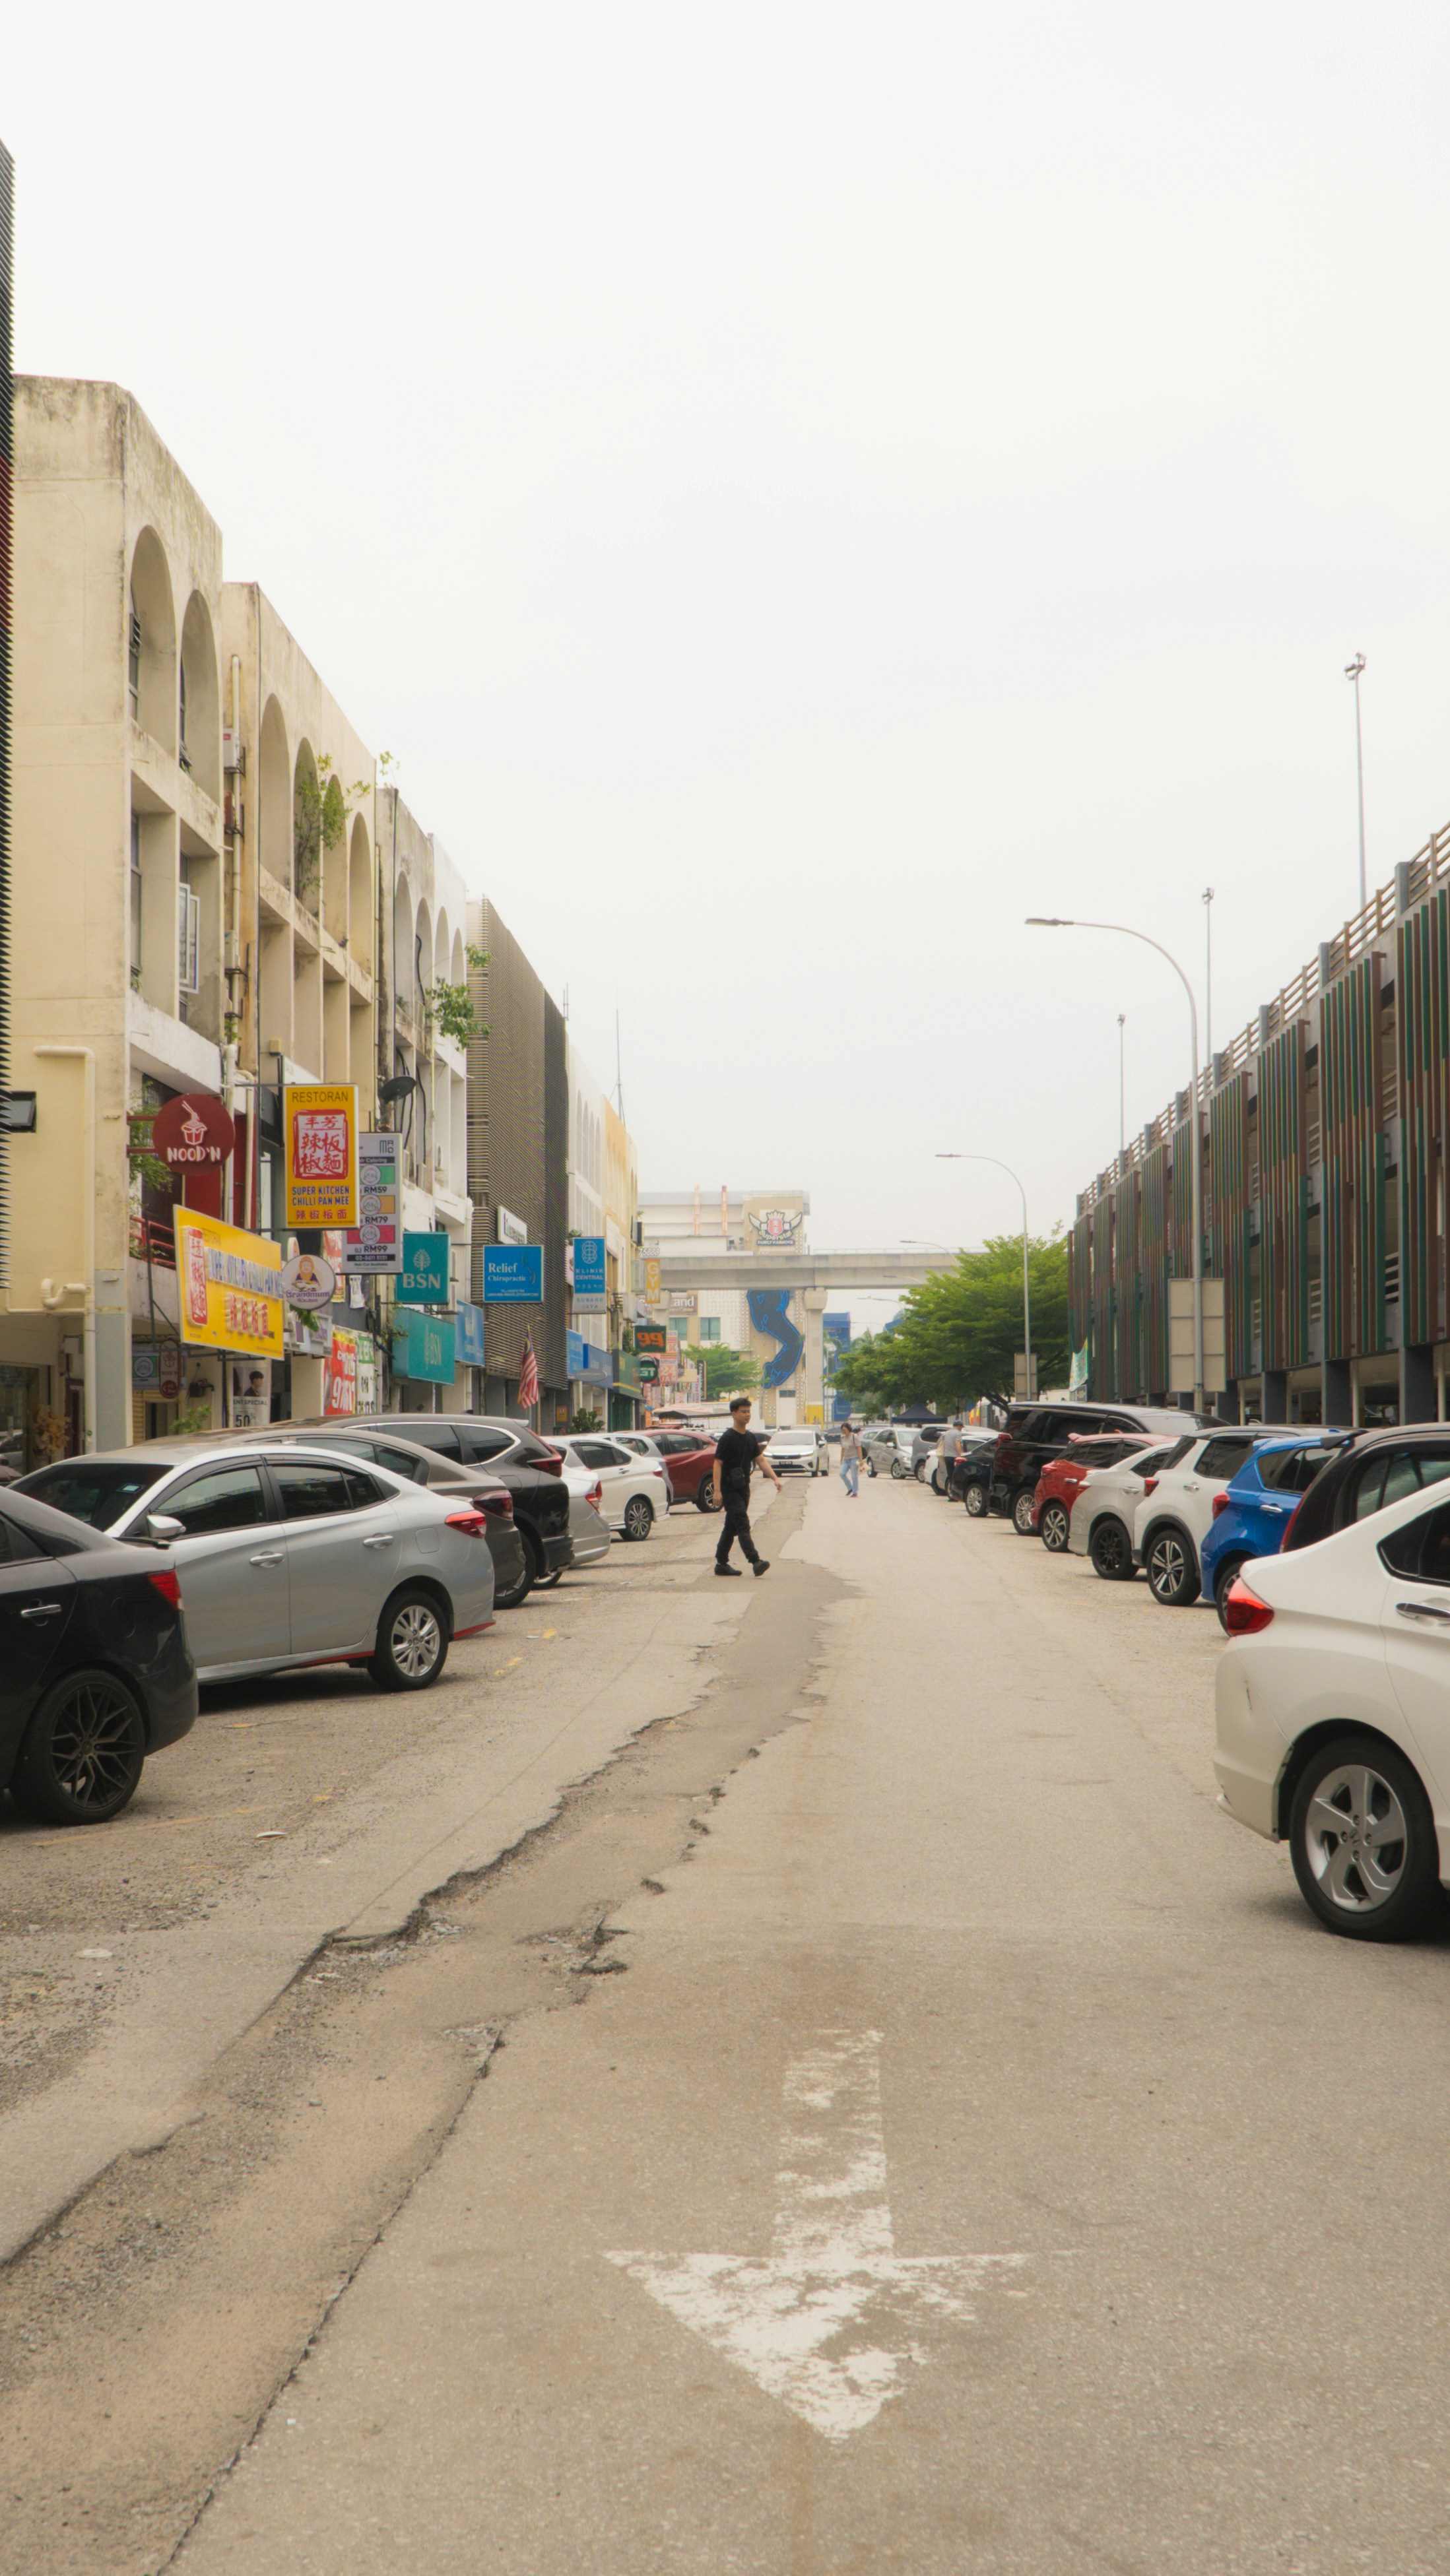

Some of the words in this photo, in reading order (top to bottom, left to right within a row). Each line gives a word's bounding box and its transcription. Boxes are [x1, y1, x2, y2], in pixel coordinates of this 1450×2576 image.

[292, 1091, 348, 1102] RESTORAN
[292, 1186, 316, 1195] SUPER
[318, 1186, 349, 1194] KITCHEN
[292, 1197, 315, 1206] CHILLI
[318, 1196, 333, 1205] PAN
[335, 1196, 349, 1205] MEE
[488, 1263, 517, 1273] Relief
[403, 1273, 441, 1289] BSN
[647, 1262, 659, 1301] GYM
[636, 1332, 665, 1348] 99
